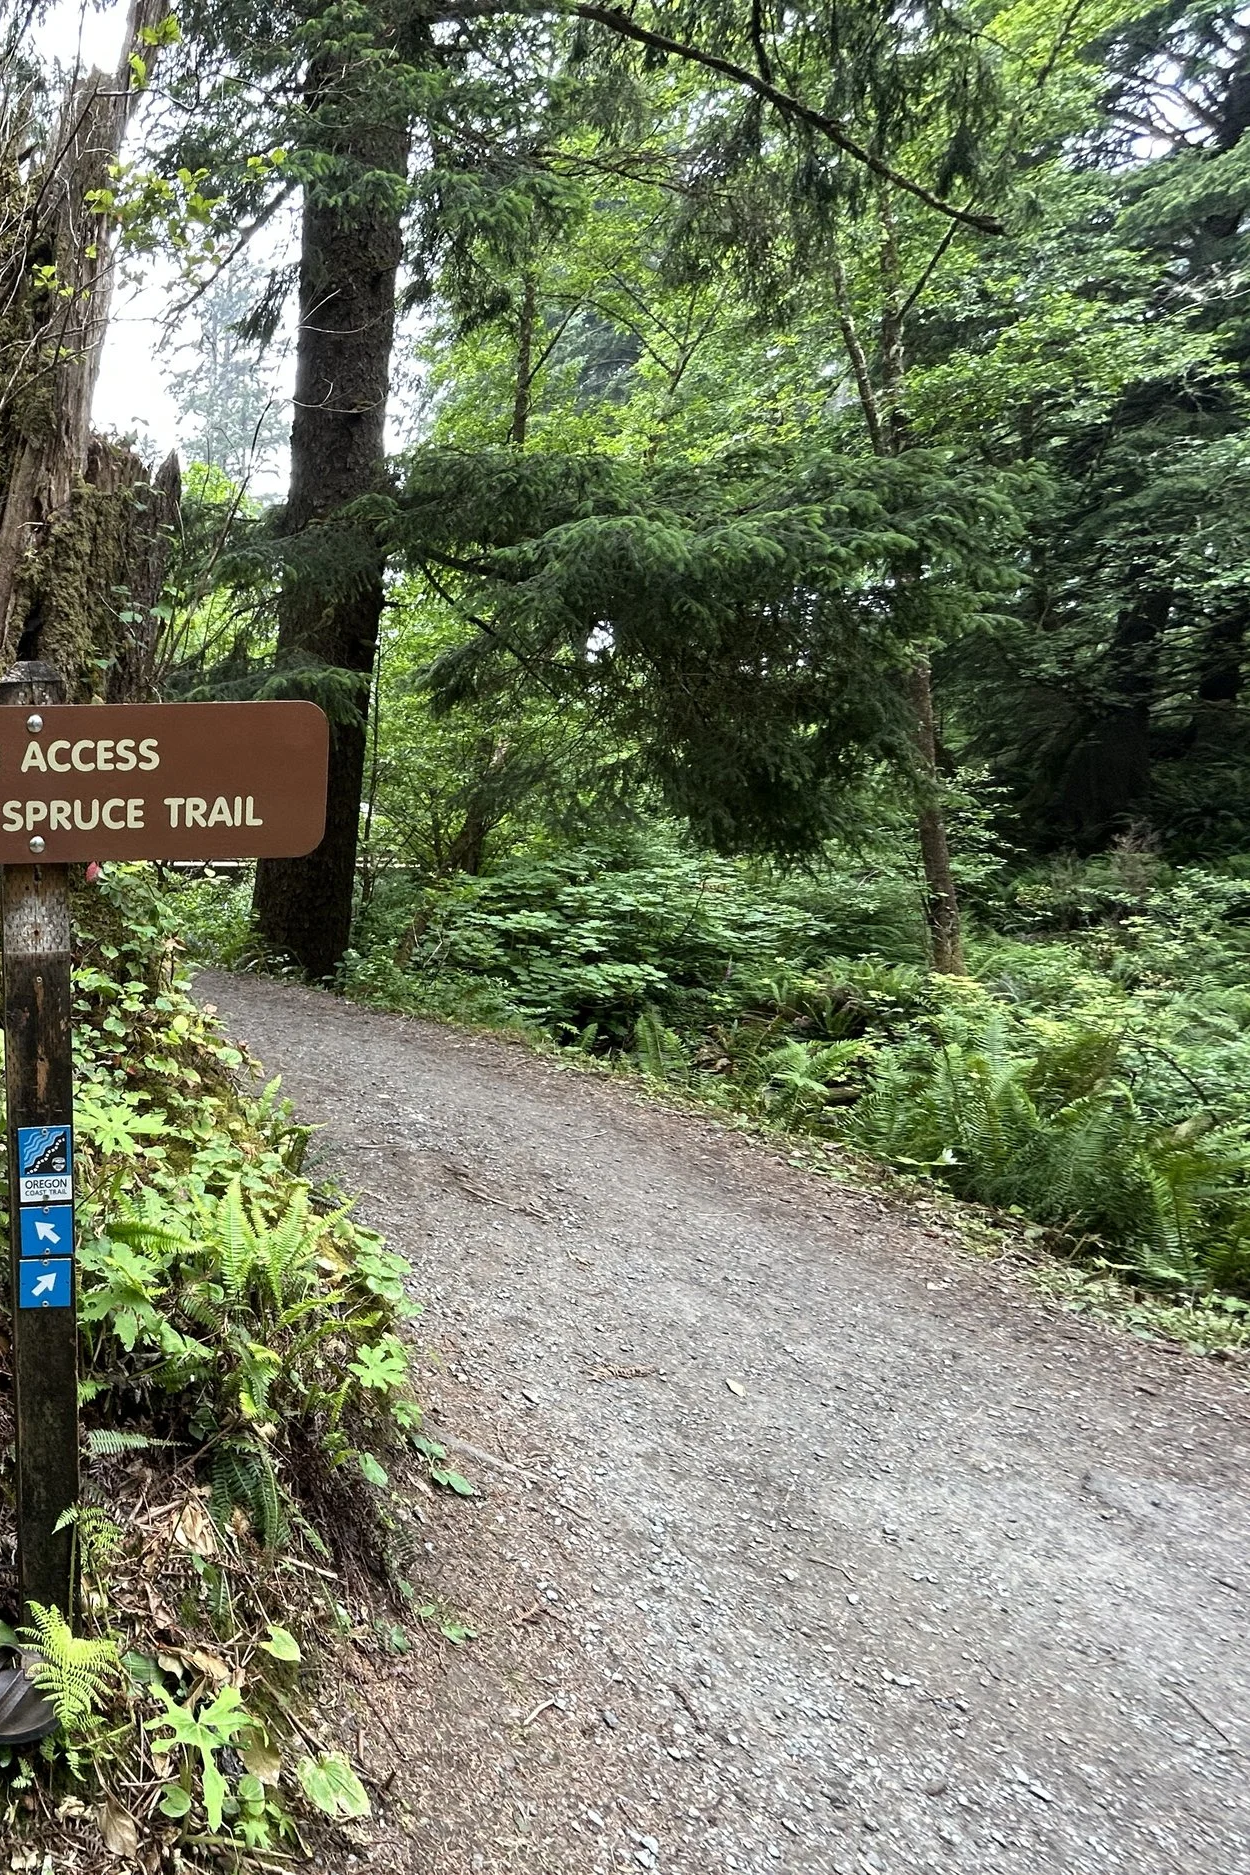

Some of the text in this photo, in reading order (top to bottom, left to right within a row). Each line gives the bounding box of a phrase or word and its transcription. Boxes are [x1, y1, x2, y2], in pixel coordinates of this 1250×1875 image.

[20, 738, 160, 773] ACCESS
[2, 797, 145, 832] SPRUCE
[163, 795, 264, 829] TRAIL
[25, 1178, 67, 1189] OREGON
